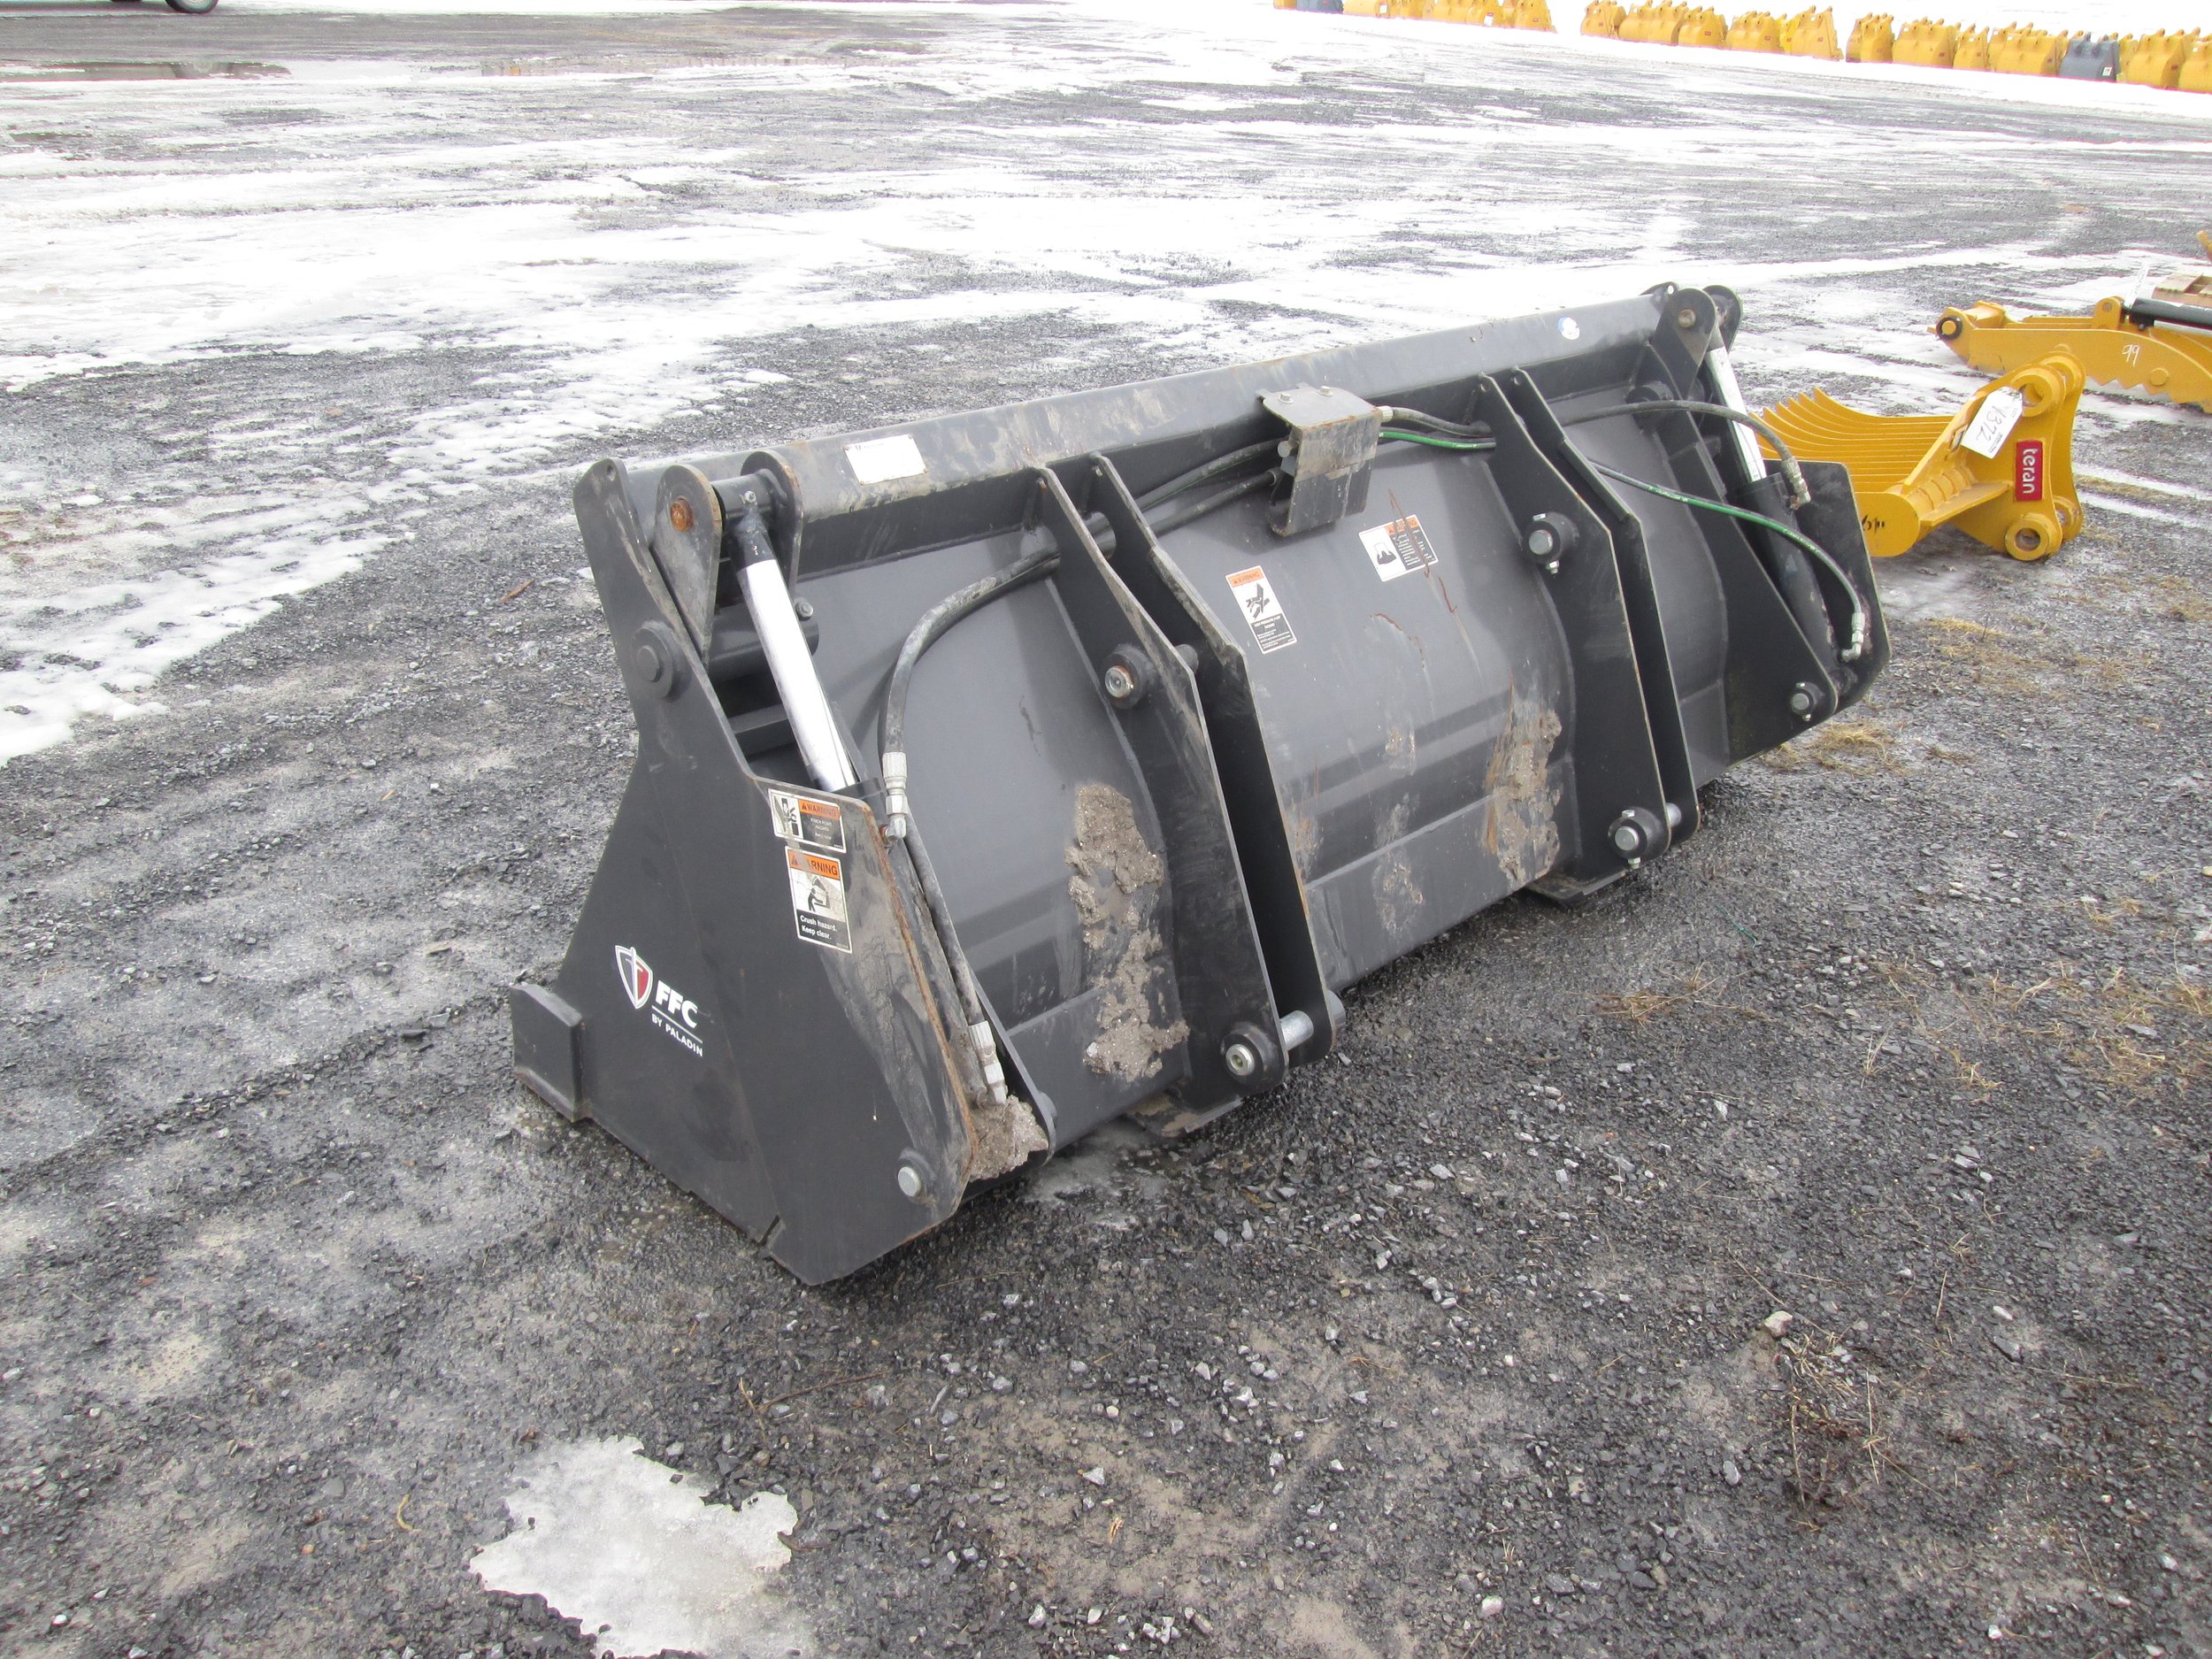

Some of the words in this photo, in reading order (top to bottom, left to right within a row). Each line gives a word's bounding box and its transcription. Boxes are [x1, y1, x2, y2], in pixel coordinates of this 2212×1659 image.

[1976, 405, 2007, 442] 1372
[2023, 448, 2039, 494] teran
[803, 857, 838, 876] RNING
[800, 914, 817, 926] Crush
[817, 919, 838, 932] hazard.
[801, 925, 816, 936] Keep
[816, 929, 832, 940] clear.
[655, 979, 698, 1028] FFC
[651, 1013, 663, 1027] BY
[664, 1023, 703, 1057] PALADIN
